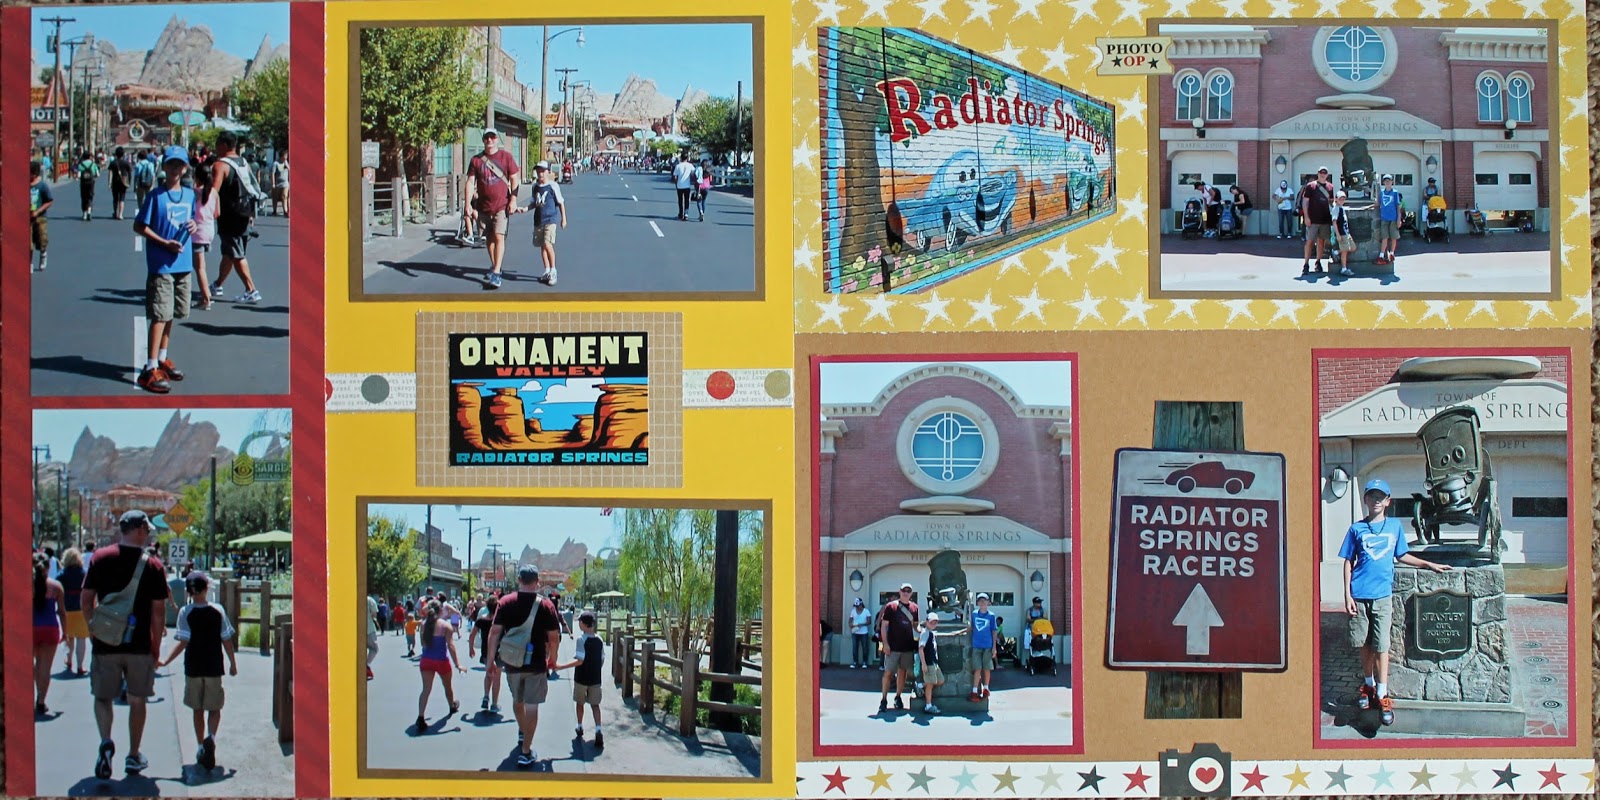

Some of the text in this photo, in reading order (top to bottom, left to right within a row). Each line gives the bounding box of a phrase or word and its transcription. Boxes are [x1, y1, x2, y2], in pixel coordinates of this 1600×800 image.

[1106, 42, 1163, 55] PHOTO
[1123, 55, 1146, 67] OP
[31, 109, 69, 120] OTL
[875, 76, 1109, 156] Radiator Springs
[1294, 121, 1418, 132] RADIATOR SPRINGS
[459, 335, 644, 366] ORNAMENT
[496, 366, 606, 377] VALLEY
[1435, 391, 1497, 402] TOWN OF
[1362, 404, 1470, 422] RADIAT
[1499, 440, 1528, 449] DEPT
[456, 452, 648, 463] RADIATOR SPRINGS
[1131, 504, 1268, 528] RADIATOR
[873, 530, 1022, 542] RADIATOR SPRINGS
[1139, 529, 1259, 553] SPRINGS
[171, 545, 186, 558] 25
[1143, 554, 1255, 578] RACERS
[1422, 612, 1465, 622] STANLEY
[1435, 622, 1452, 630] OUR
[1426, 629, 1461, 638] FOUNDER
